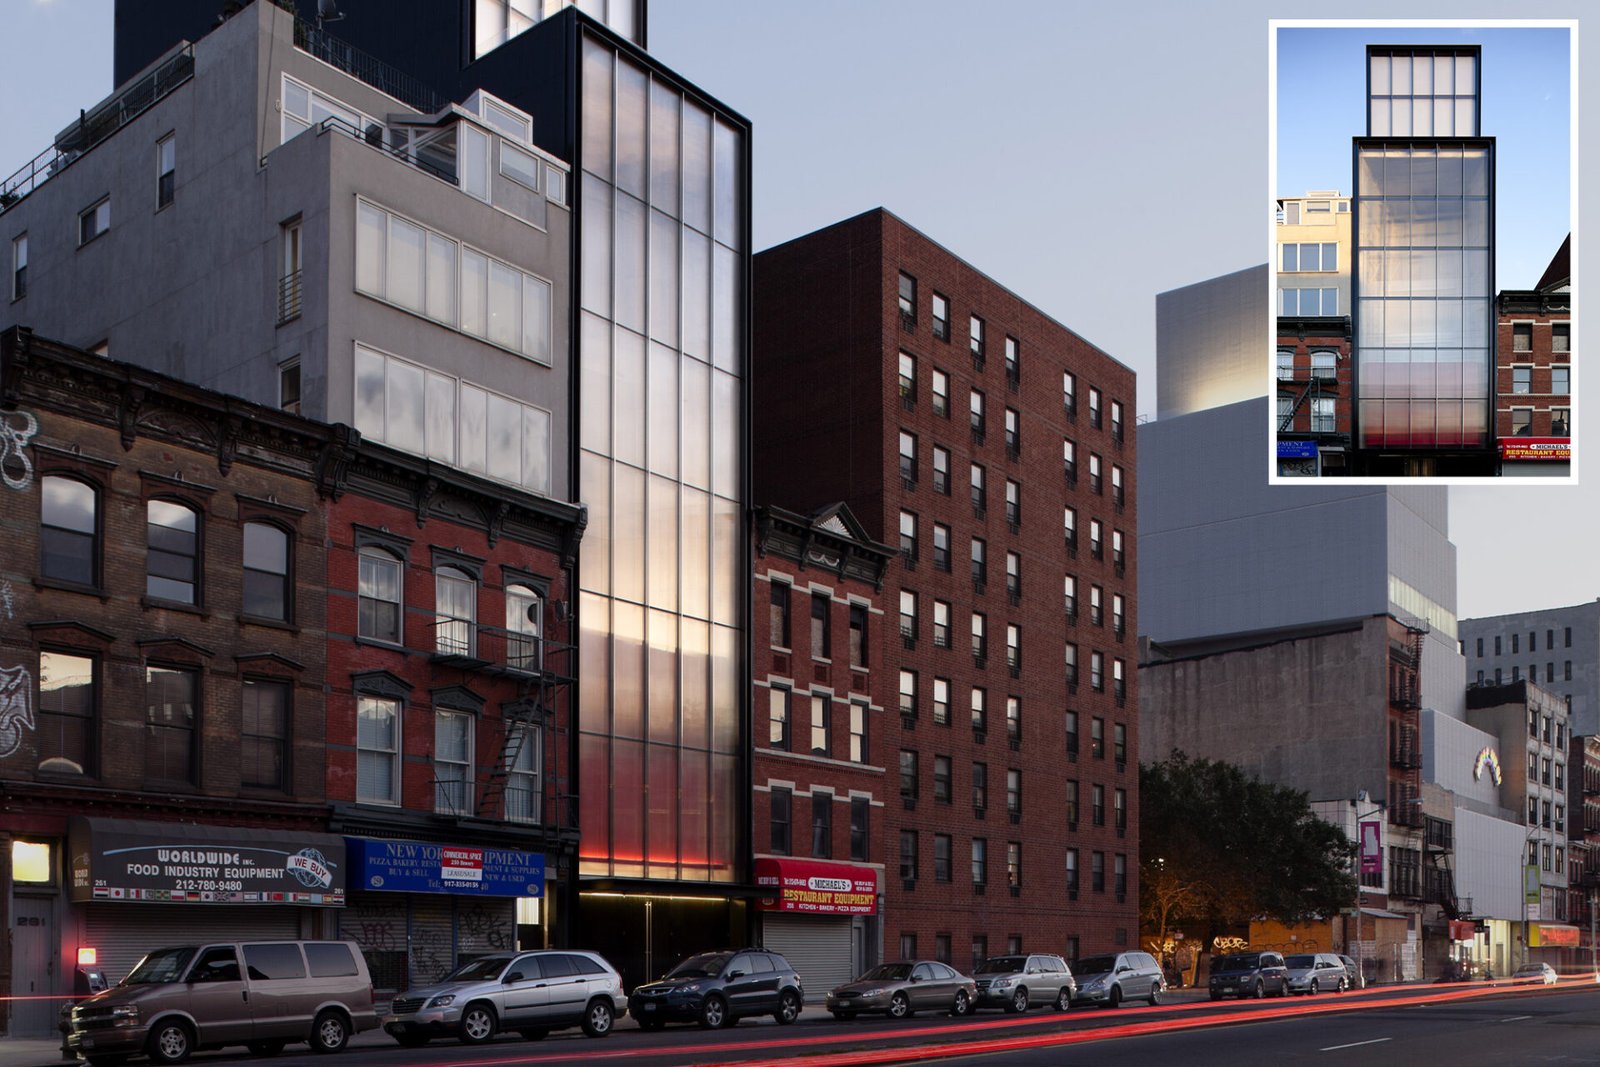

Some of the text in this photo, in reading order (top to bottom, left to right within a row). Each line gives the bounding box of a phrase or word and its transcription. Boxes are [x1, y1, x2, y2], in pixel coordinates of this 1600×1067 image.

[157, 849, 240, 865] WORLDWIDE
[386, 843, 418, 858] NEW
[483, 851, 531, 866] IPMENT
[443, 851, 469, 859] COMMERCIAL
[127, 863, 285, 879] FOOD INDUSTRY EQUIPMENT
[294, 856, 327, 879] WE BUY
[511, 866, 540, 875] SUPPLIES
[389, 868, 402, 876] BUY
[412, 868, 429, 877] SELL
[484, 873, 499, 881] NEW
[508, 874, 525, 882] USED
[175, 879, 242, 891] 212-780-9480
[427, 879, 441, 888] Tel:
[814, 879, 847, 890] MICHAEL'S
[783, 889, 833, 903] RESTAURANT
[834, 893, 874, 905] EQUIPMENT
